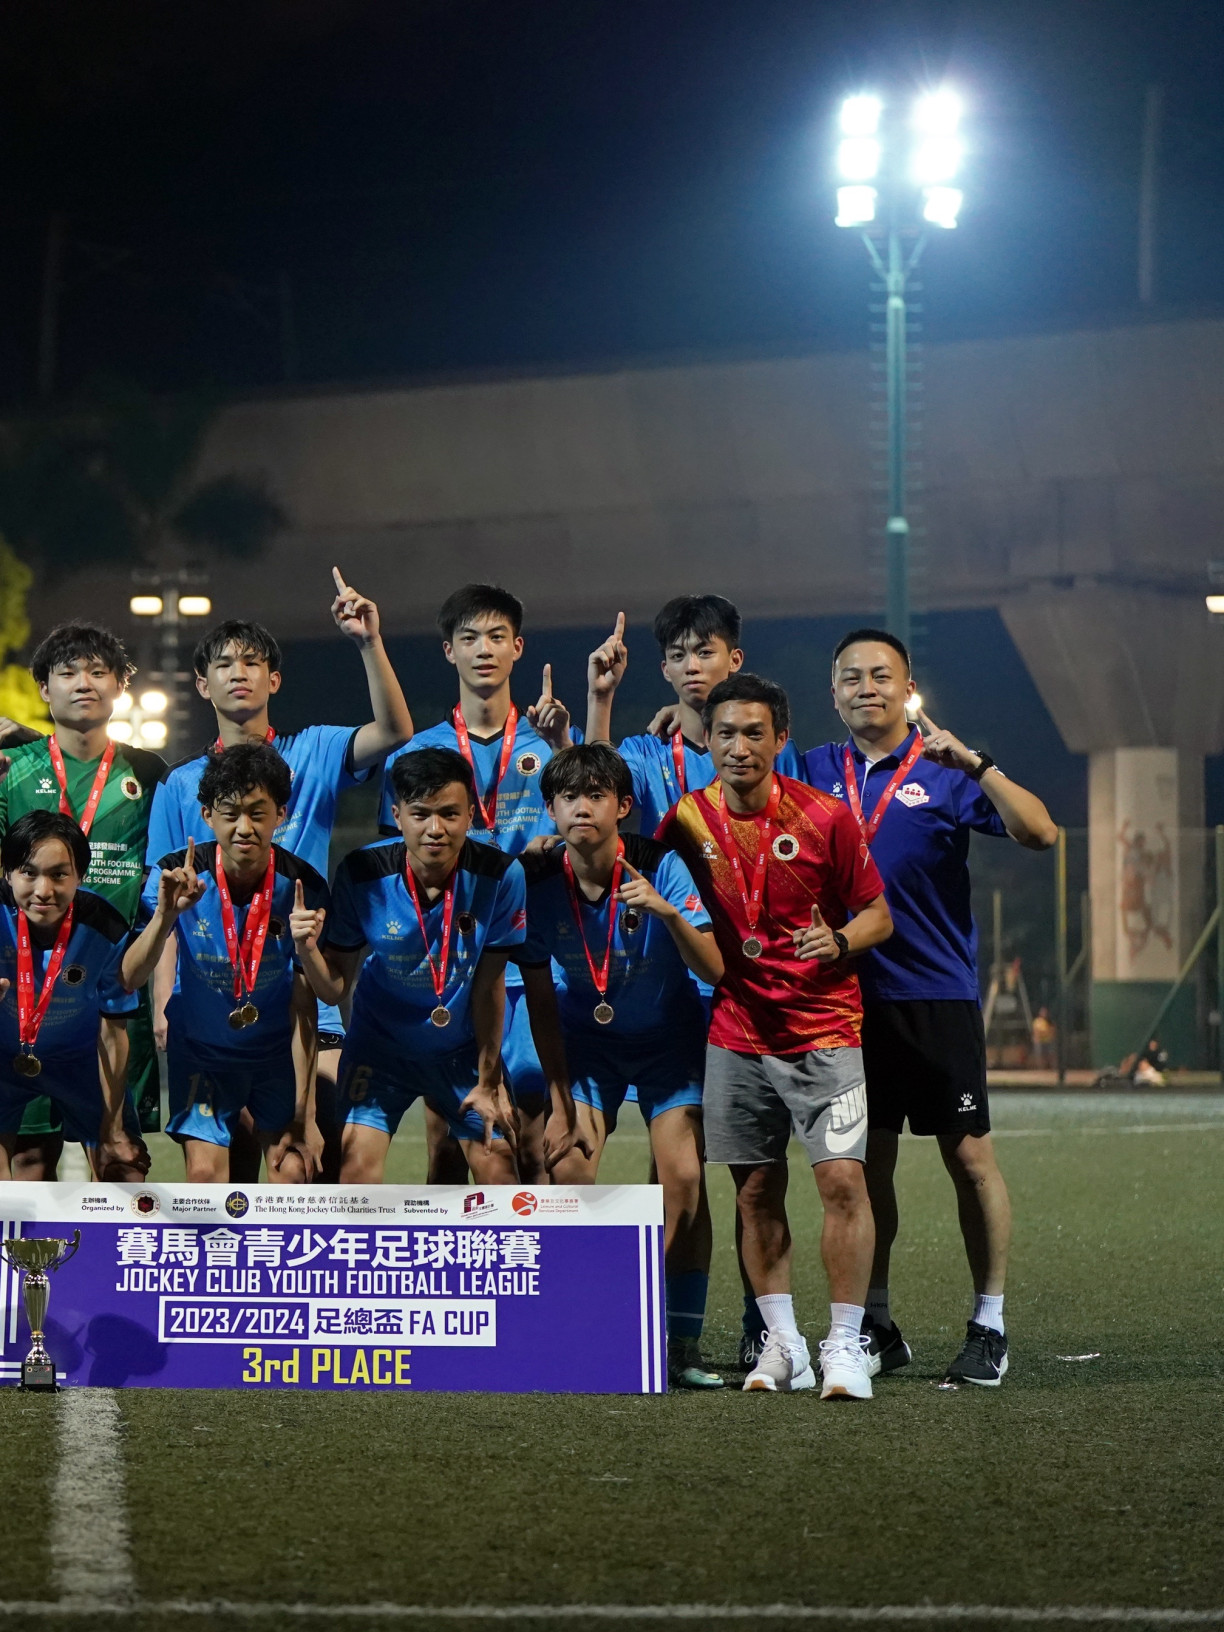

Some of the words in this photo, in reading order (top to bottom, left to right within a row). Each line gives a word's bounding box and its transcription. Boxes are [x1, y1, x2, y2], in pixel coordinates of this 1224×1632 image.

[907, 754, 915, 764] HKFA
[889, 782, 897, 792] HKFA
[107, 860, 141, 869] FOOTBALL
[958, 1104, 977, 1112] KELME
[255, 1196, 369, 1204] 香港賽馬會慈善信託基金
[254, 1205, 266, 1213] The
[268, 1205, 287, 1215] Hong
[288, 1205, 305, 1215] Kong
[306, 1205, 328, 1215] Jockey
[330, 1205, 345, 1213] Club
[347, 1205, 376, 1213] Charities
[440, 1207, 448, 1215] by
[116, 1227, 541, 1270] 賽馬會青少年足球聯賽
[116, 1268, 199, 1292] JOCKEY
[206, 1269, 260, 1293] CLUB
[268, 1269, 338, 1294] YOUTH
[346, 1270, 452, 1295] FOOTBALL
[460, 1271, 540, 1296] LEAGUE
[171, 1307, 305, 1334] 2023/2024
[314, 1307, 403, 1335] 足總盃
[409, 1310, 436, 1335] FA
[444, 1310, 489, 1336] CUP
[242, 1347, 299, 1383] 3rd
[312, 1348, 411, 1384] PLACE
